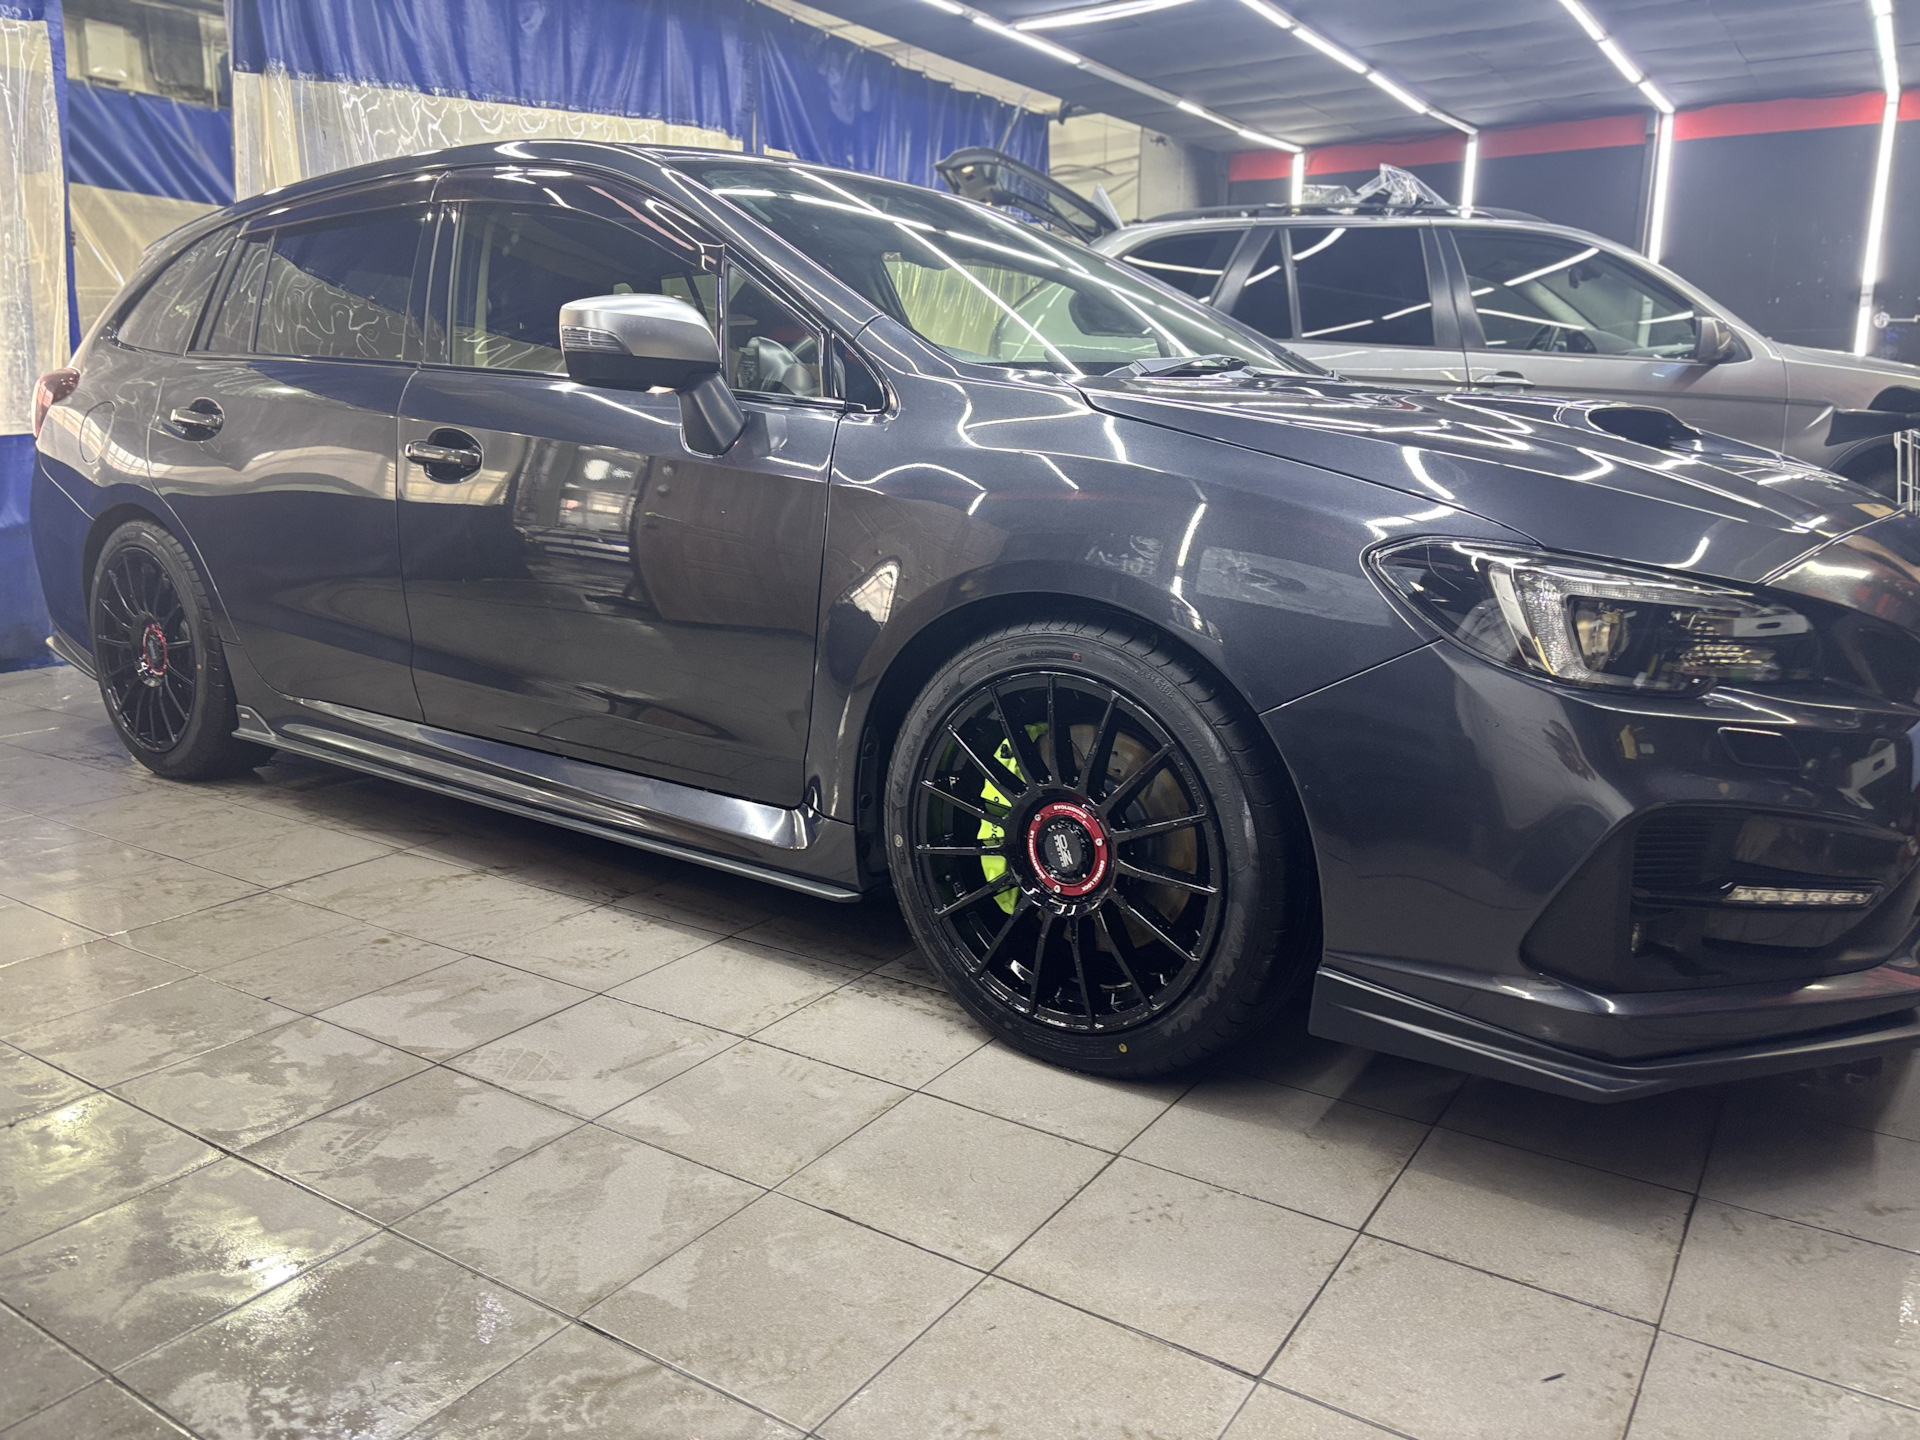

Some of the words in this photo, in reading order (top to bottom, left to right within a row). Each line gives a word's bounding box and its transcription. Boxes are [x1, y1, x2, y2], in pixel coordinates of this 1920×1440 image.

[1053, 804, 1088, 819] EVOLUZIONE
[1094, 859, 1105, 882] CENTRAL
[1080, 880, 1096, 892] LOCK
